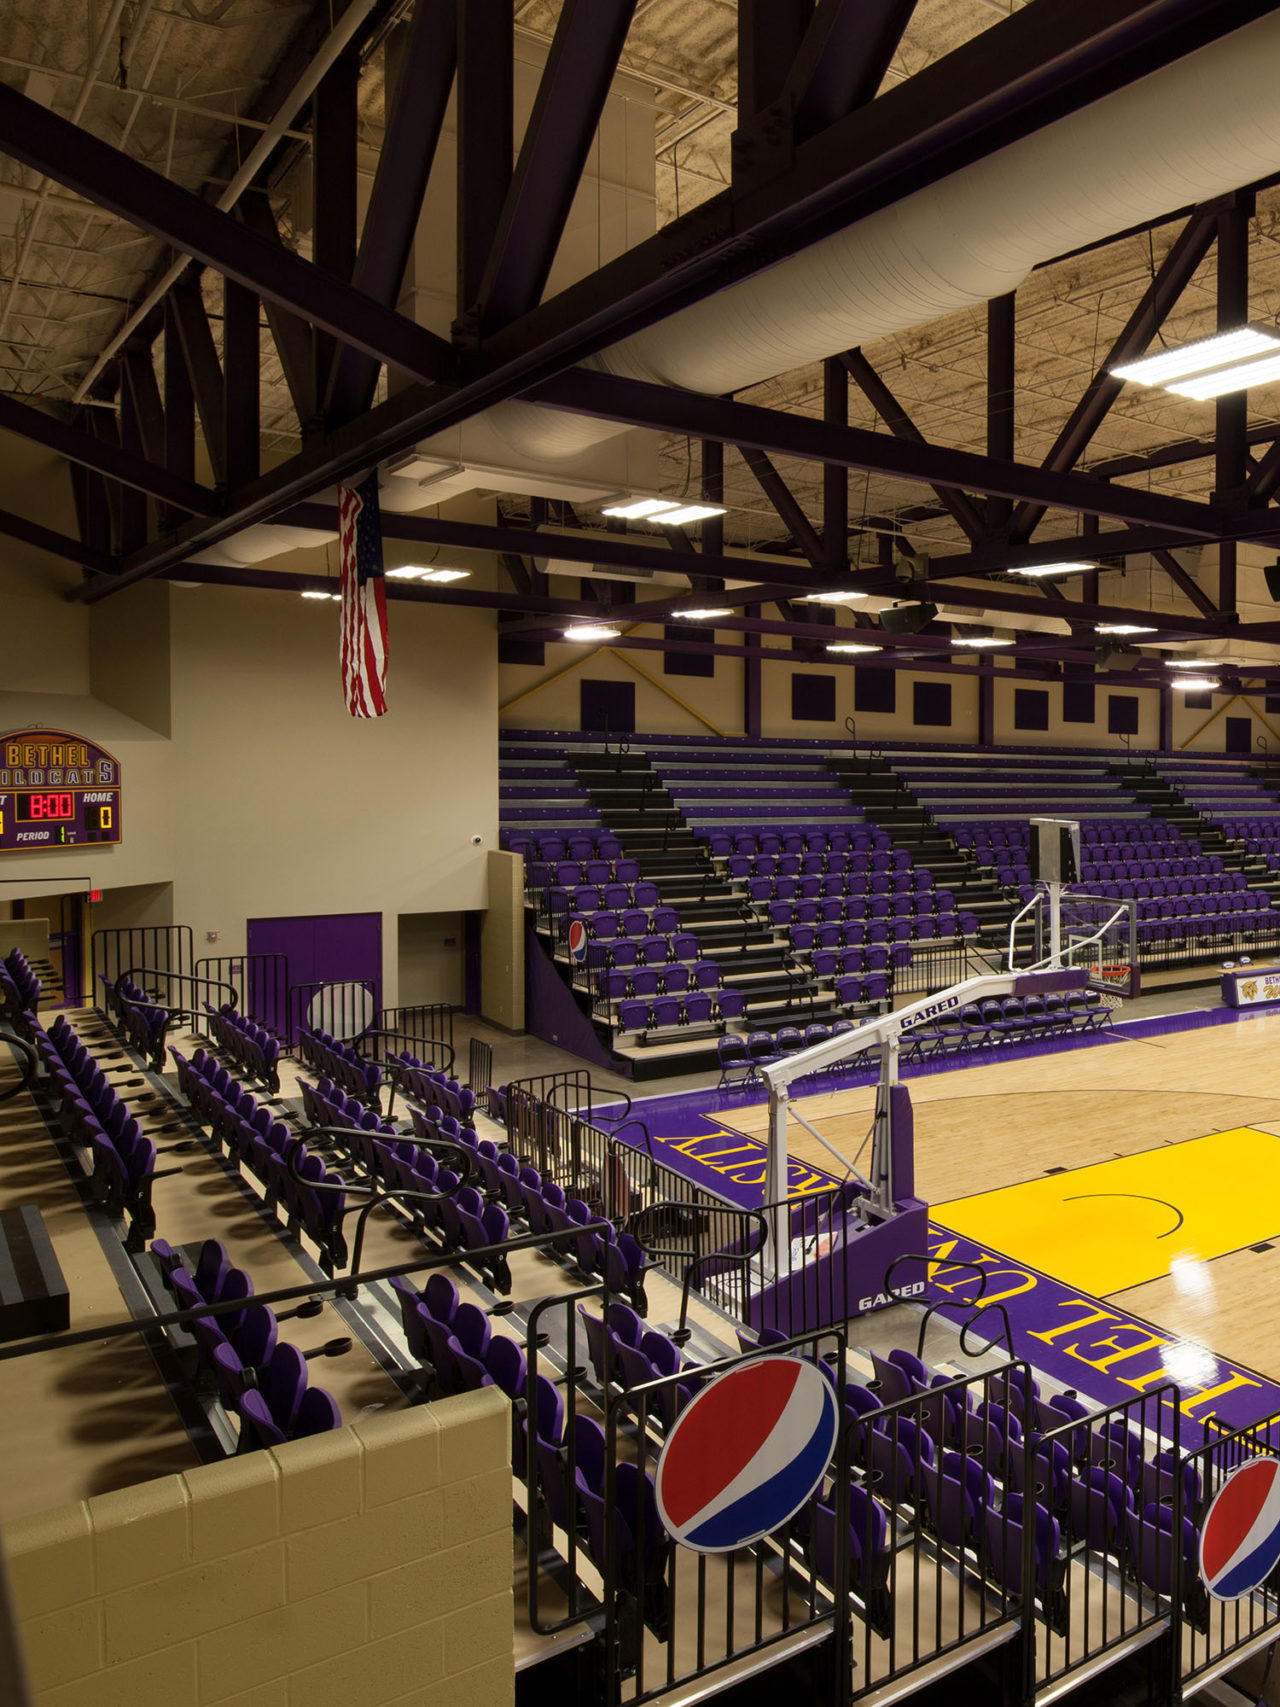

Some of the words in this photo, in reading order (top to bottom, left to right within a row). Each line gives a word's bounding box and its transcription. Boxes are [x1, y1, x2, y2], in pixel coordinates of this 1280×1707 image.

[6, 743, 90, 768] BETHEL
[0, 758, 114, 786] ILDCATS
[30, 794, 72, 818] 8:00
[83, 792, 113, 803] HOME
[100, 806, 112, 829] 0
[16, 831, 50, 841] PERIOD
[60, 825, 65, 843] 1
[900, 996, 958, 1029] GARED
